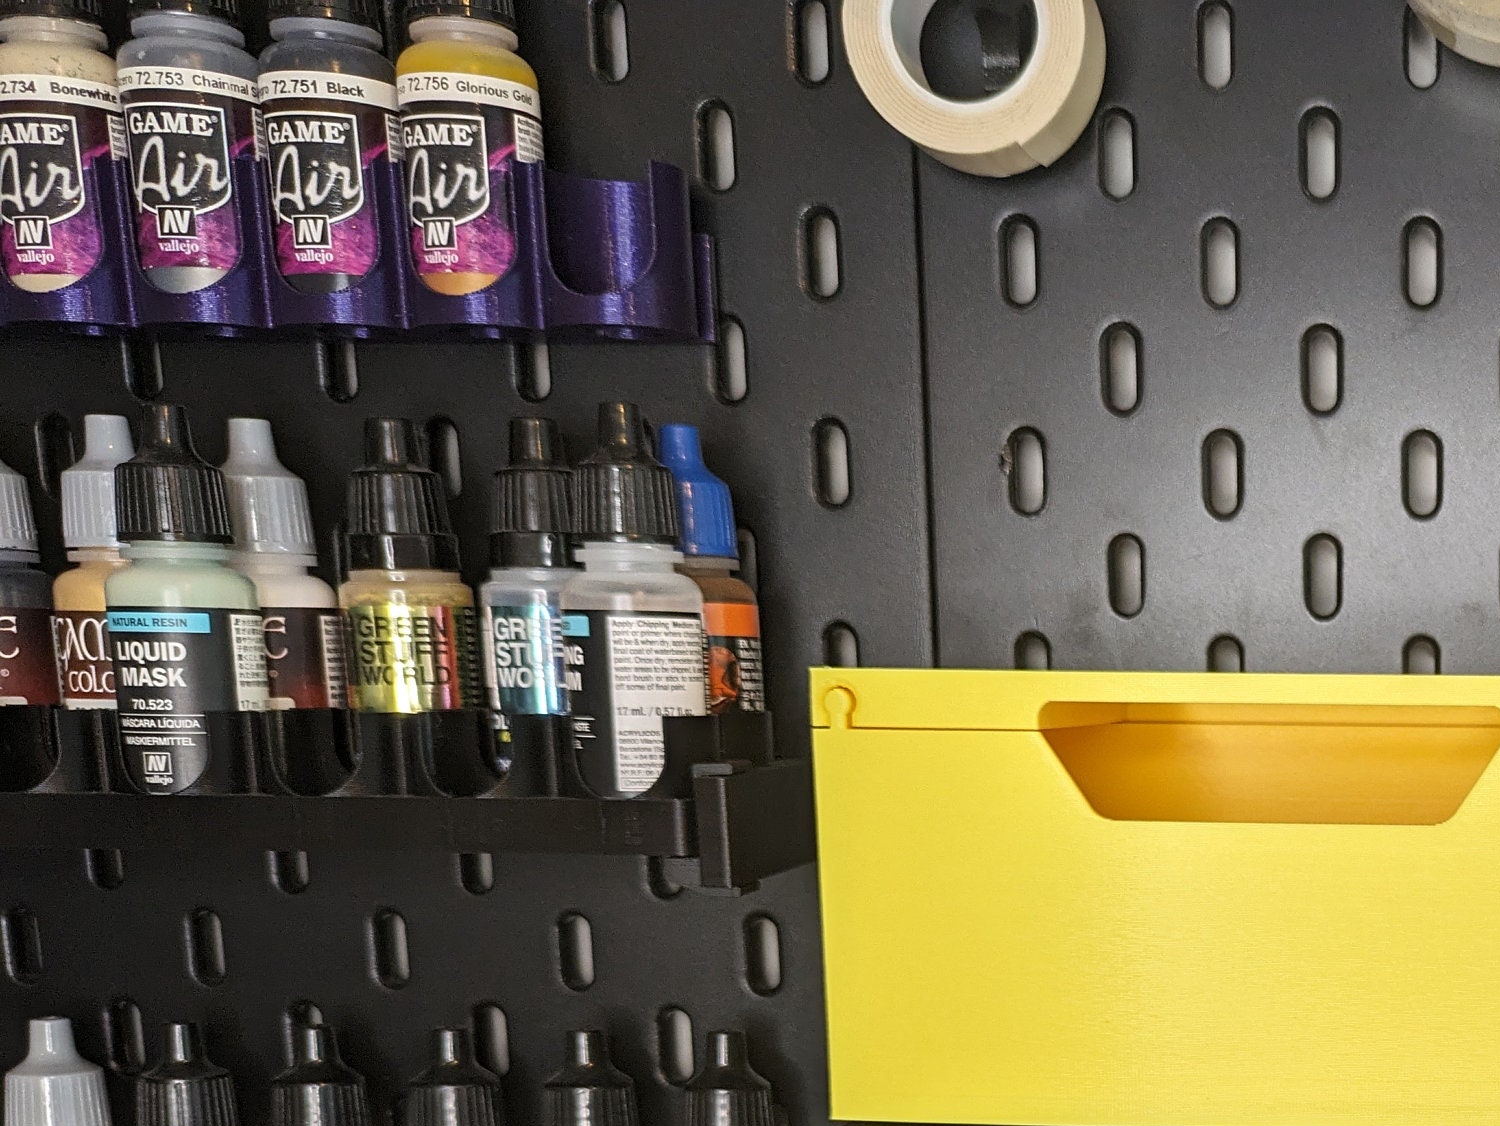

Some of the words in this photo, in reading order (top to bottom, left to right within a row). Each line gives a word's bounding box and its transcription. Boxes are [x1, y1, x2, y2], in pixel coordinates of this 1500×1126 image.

[136, 72, 184, 86] 72.753
[272, 80, 318, 96] 72.751
[327, 82, 365, 99] Black
[408, 76, 449, 92] 72.756
[456, 81, 509, 100] Glorious
[50, 82, 118, 104] Bonewhite
[0, 121, 66, 146] AME
[129, 112, 214, 138] GAME
[268, 120, 347, 145] GAME
[403, 123, 474, 148] GAME
[135, 135, 230, 214] Air
[274, 145, 362, 226] Air
[408, 148, 488, 227] Air
[17, 250, 55, 266] vallejo
[158, 239, 200, 255] vallejo
[295, 249, 334, 265] vallejo
[424, 250, 459, 266] vallejo
[112, 617, 149, 627] NATURAL
[152, 618, 188, 628] RESIN
[359, 616, 446, 639] GREEN
[117, 641, 187, 664] LIQUID
[361, 641, 449, 665] STUFF
[122, 667, 187, 688] MASK
[361, 666, 451, 686] WORLD
[132, 698, 173, 711] 70.523
